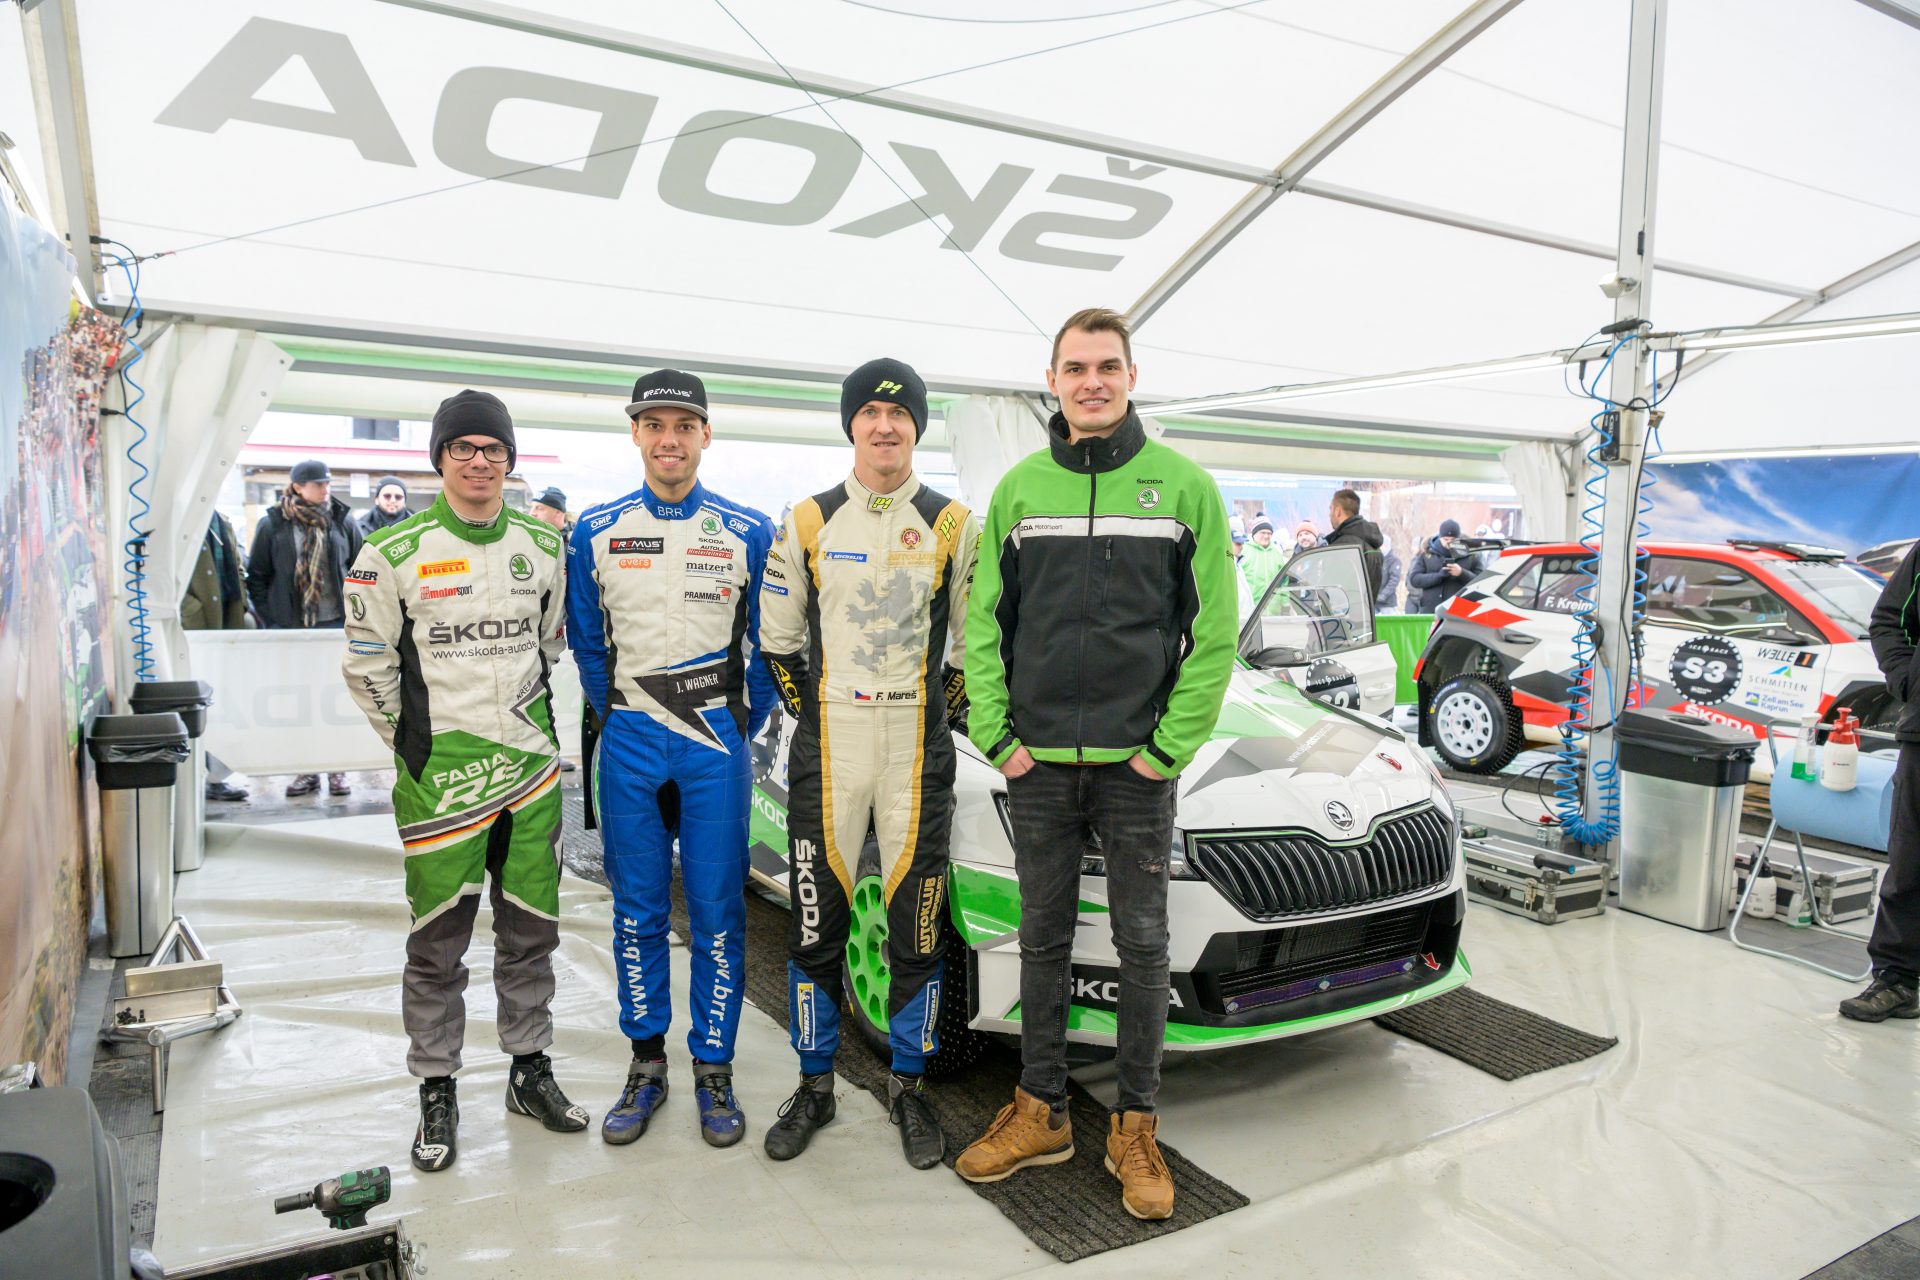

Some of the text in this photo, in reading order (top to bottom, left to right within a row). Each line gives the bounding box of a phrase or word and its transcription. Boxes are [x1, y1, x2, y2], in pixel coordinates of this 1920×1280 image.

[645, 388, 692, 398] REMUS
[657, 505, 684, 517] BRR
[590, 515, 612, 529] OMP
[729, 518, 750, 534] OMP
[390, 539, 412, 557] OMP
[537, 536, 557, 549] OMP
[617, 540, 661, 548] REMUS
[700, 545, 734, 553] AUTOLAND
[833, 553, 865, 561] MICHELIN
[420, 561, 465, 575] PIRELLI
[686, 562, 726, 572] matzer
[765, 567, 786, 580] ODA
[684, 592, 721, 600] PRAMMER
[1545, 596, 1555, 608] F.
[429, 617, 533, 645] ŠKODA
[1681, 656, 1728, 684] S3
[676, 673, 719, 694] J. WAGNER
[1749, 675, 1808, 692] SCHMITTEN
[876, 690, 917, 701] F. Mareš
[432, 753, 513, 788] FABIA
[435, 755, 529, 815] R5
[752, 788, 788, 832] KOD
[794, 838, 820, 947] ŠKODA
[920, 877, 936, 954] AUTOKLUB
[706, 930, 733, 1048] www.brr.at
[1071, 978, 1185, 1008] KOA
[802, 1002, 810, 1045] MICHELIN
